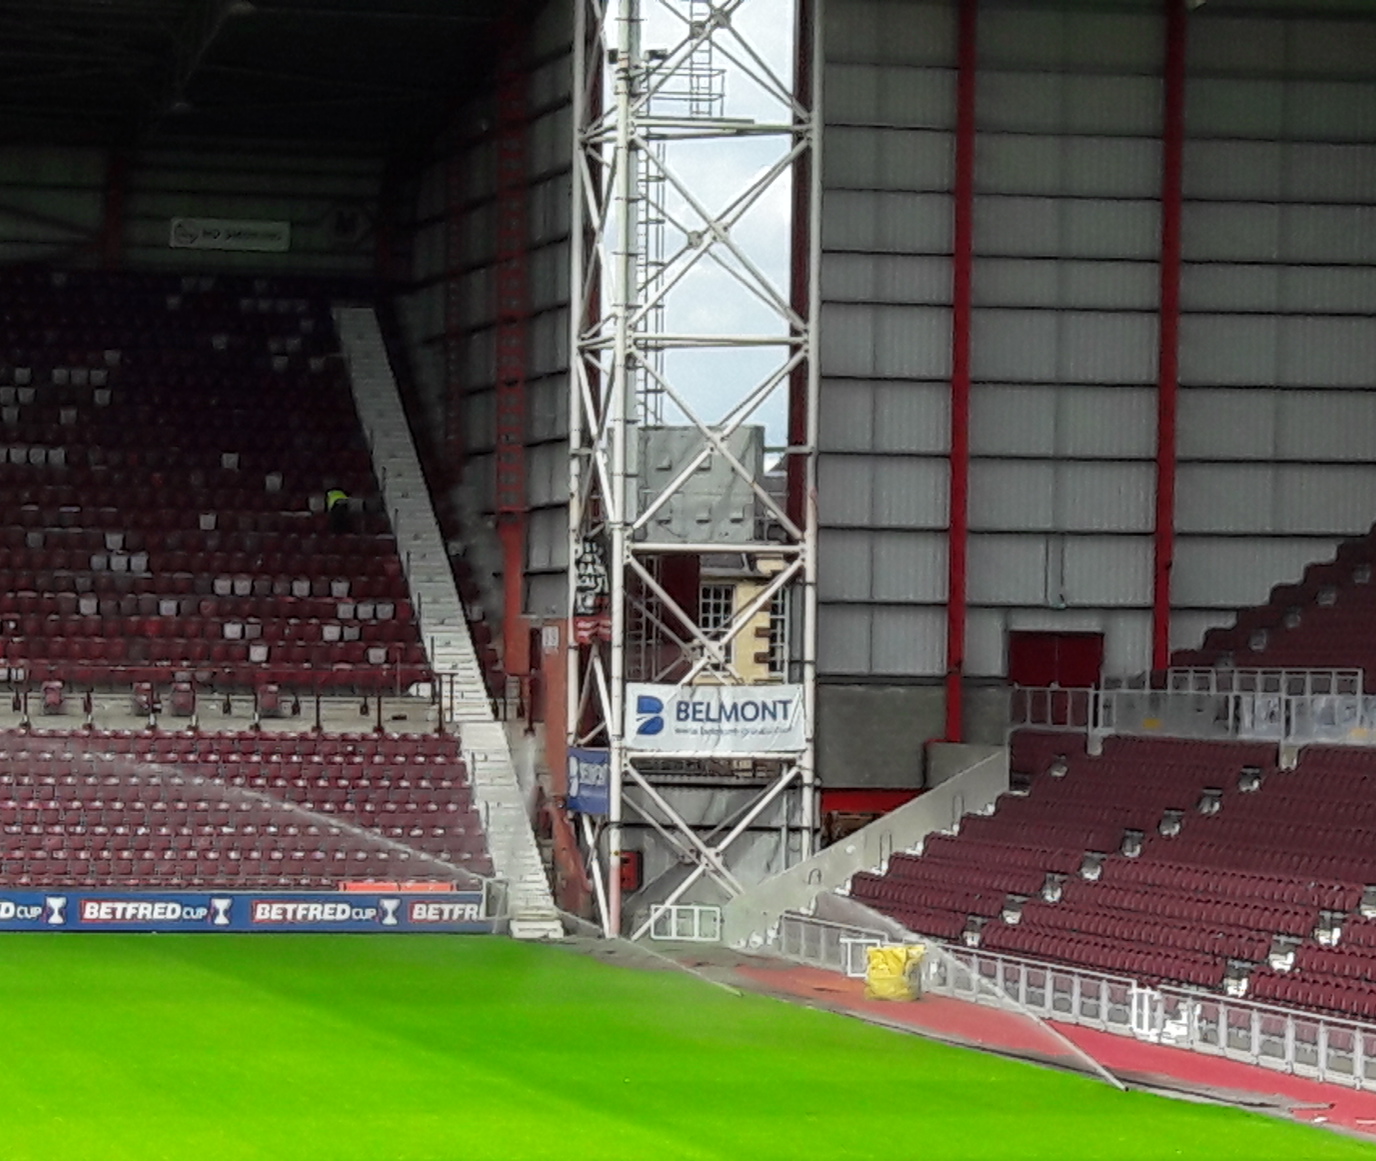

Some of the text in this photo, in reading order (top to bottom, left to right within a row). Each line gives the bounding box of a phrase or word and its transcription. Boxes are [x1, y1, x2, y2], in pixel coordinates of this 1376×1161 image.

[675, 699, 793, 724] BELMONT
[16, 905, 43, 919] CUP
[83, 901, 208, 920] BETFRED CUP
[255, 902, 377, 921] BETFRED CUP
